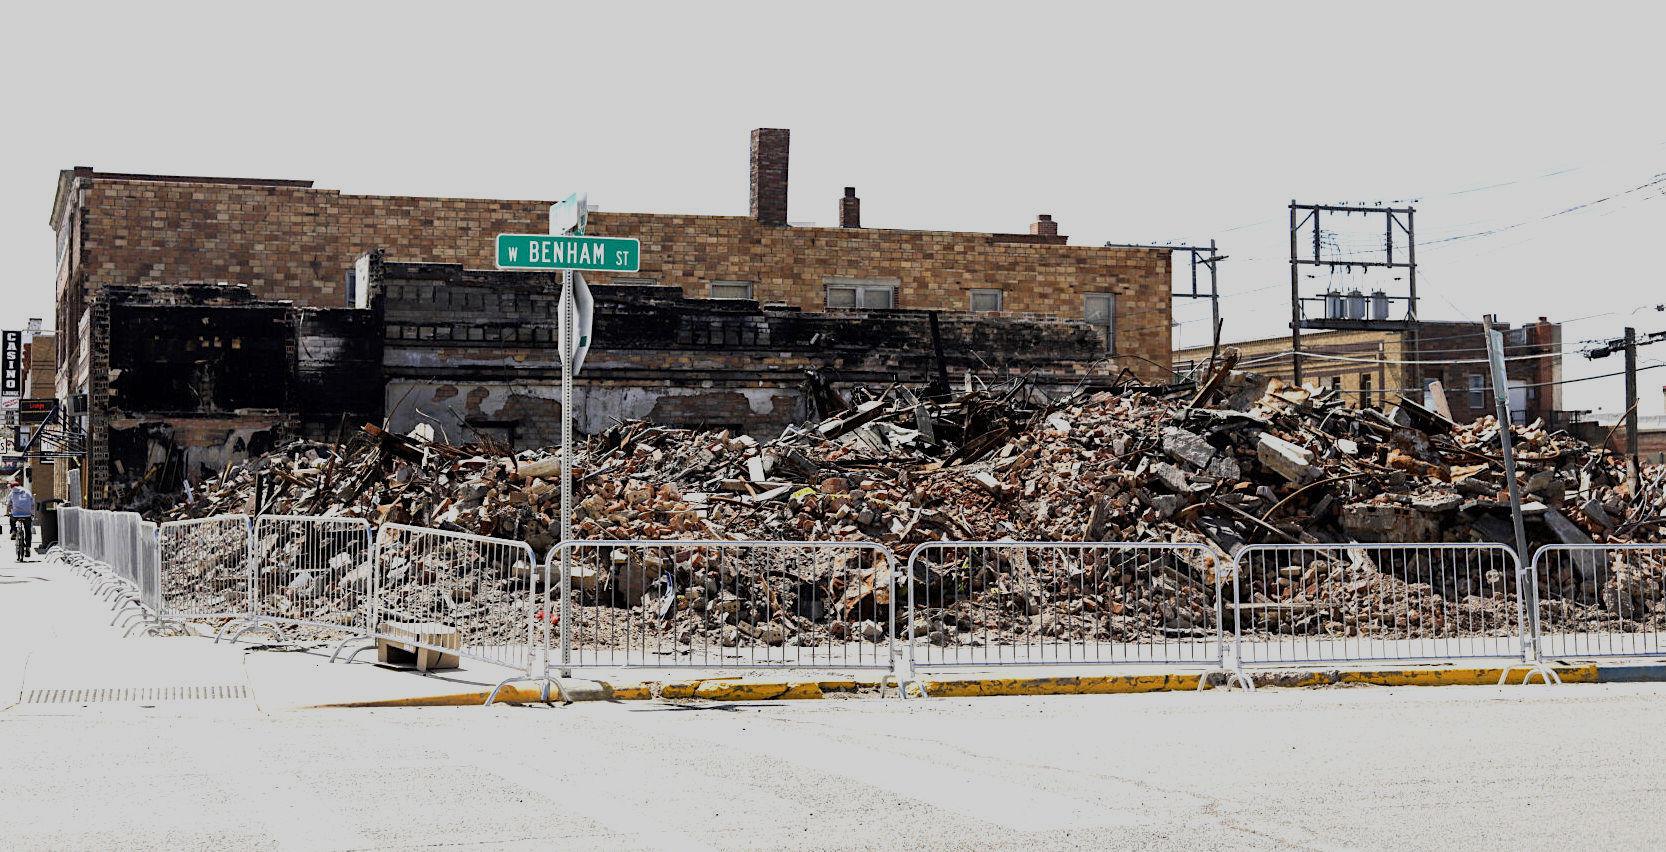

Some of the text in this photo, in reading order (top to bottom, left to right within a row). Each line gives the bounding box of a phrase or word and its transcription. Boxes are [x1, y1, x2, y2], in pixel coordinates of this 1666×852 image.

[508, 240, 629, 266] W BENHAM ST
[6, 332, 17, 389] CASINO
